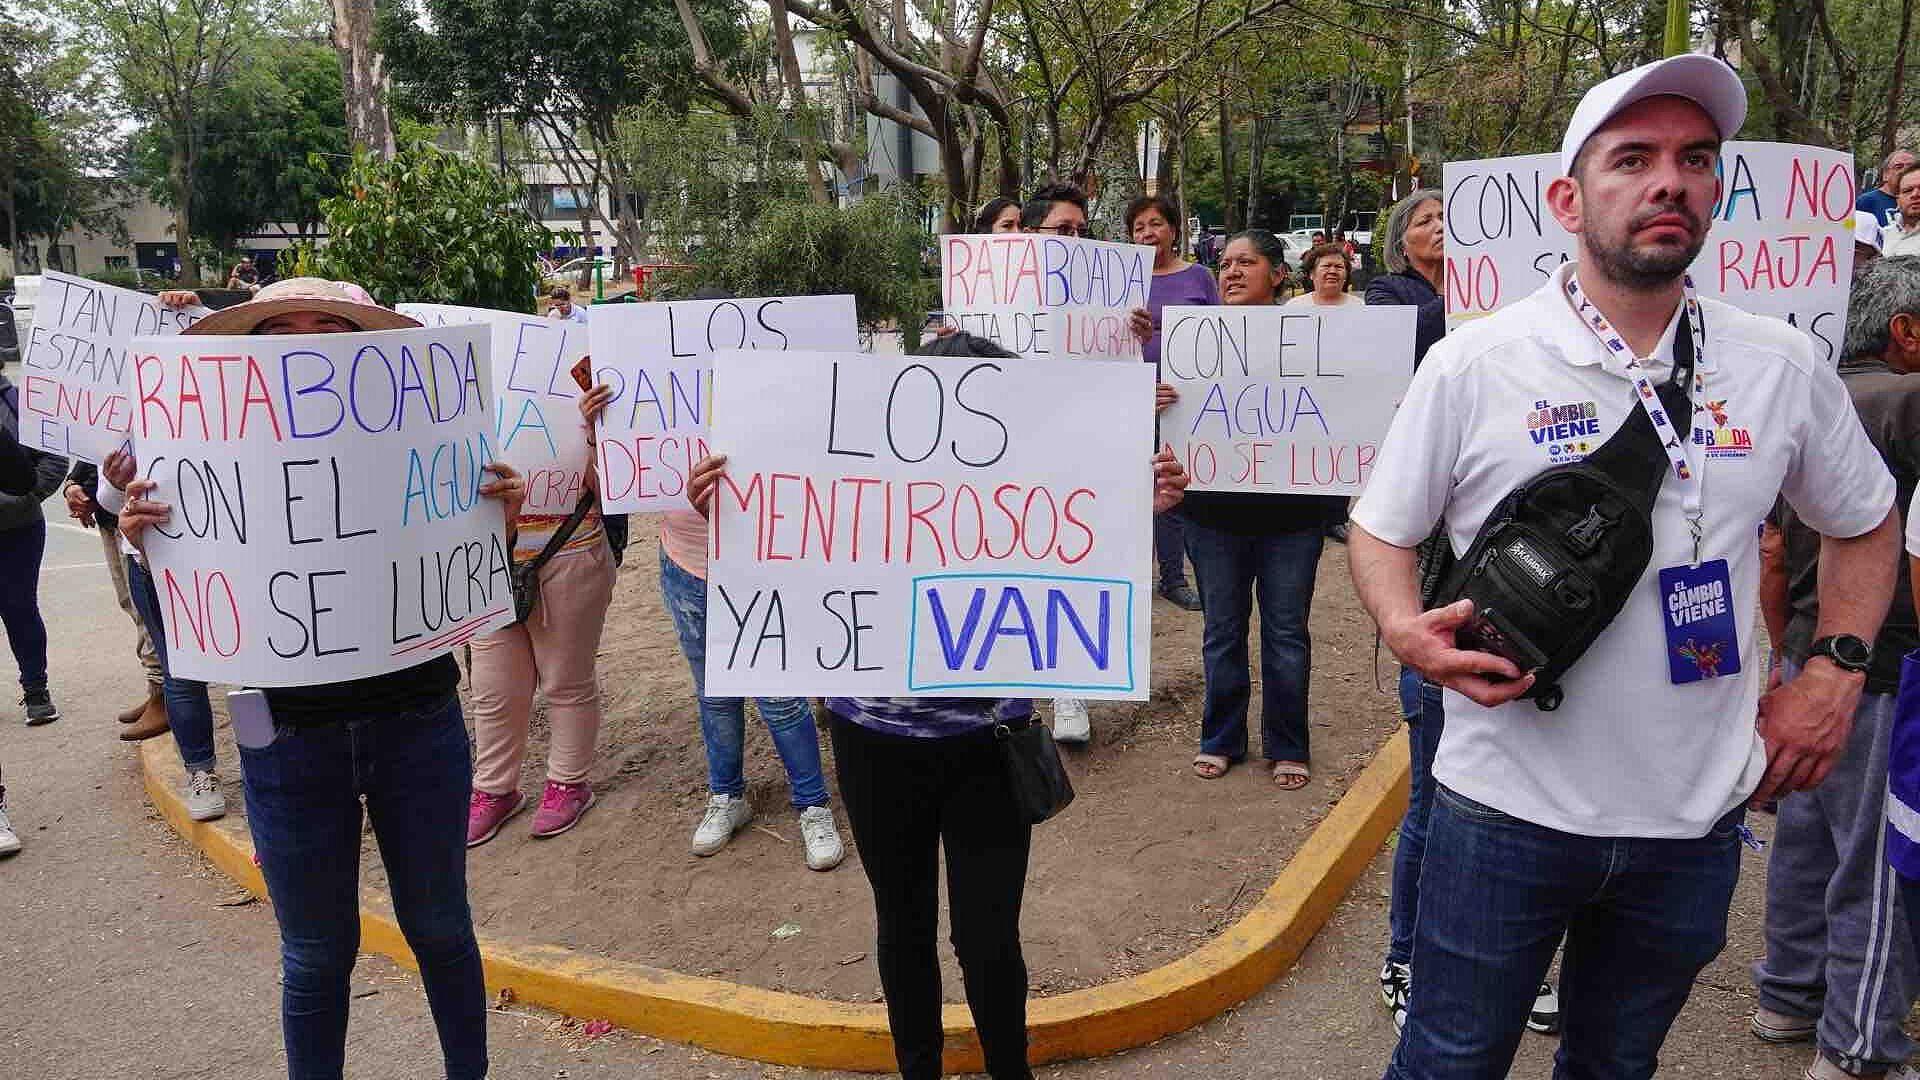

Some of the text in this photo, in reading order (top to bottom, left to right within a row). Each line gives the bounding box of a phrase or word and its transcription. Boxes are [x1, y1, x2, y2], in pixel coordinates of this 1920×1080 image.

[1447, 170, 1543, 246] CON
[1786, 158, 1854, 222] NO
[947, 238, 1146, 308] RATABOADA
[1447, 255, 1499, 314] NO
[1719, 236, 1837, 293] RAJA
[46, 276, 118, 337] TAN
[668, 301, 787, 357] LOS
[1015, 312, 1049, 353] DE
[26, 325, 128, 385] ESTAN
[507, 322, 578, 398] EL
[1166, 315, 1345, 380] CON EL
[134, 342, 486, 443] RATABOADA
[827, 361, 1008, 468] LOS
[1191, 383, 1330, 439] AGUA
[1526, 401, 1599, 430] CAMBIO
[1535, 399, 1551, 411] EL
[41, 418, 94, 461] EL
[1529, 418, 1601, 445] VIENE
[1230, 442, 1273, 484] SE
[146, 456, 247, 545] CON
[283, 456, 377, 544] EL
[714, 472, 1096, 568] MENTIROSOS
[165, 533, 512, 658] NO SE LUCRA
[1668, 579, 1724, 612] CAMBIO
[1671, 597, 1727, 627] VIENE
[1674, 580, 1688, 593] EL
[717, 584, 1111, 672] YA SE VAN
